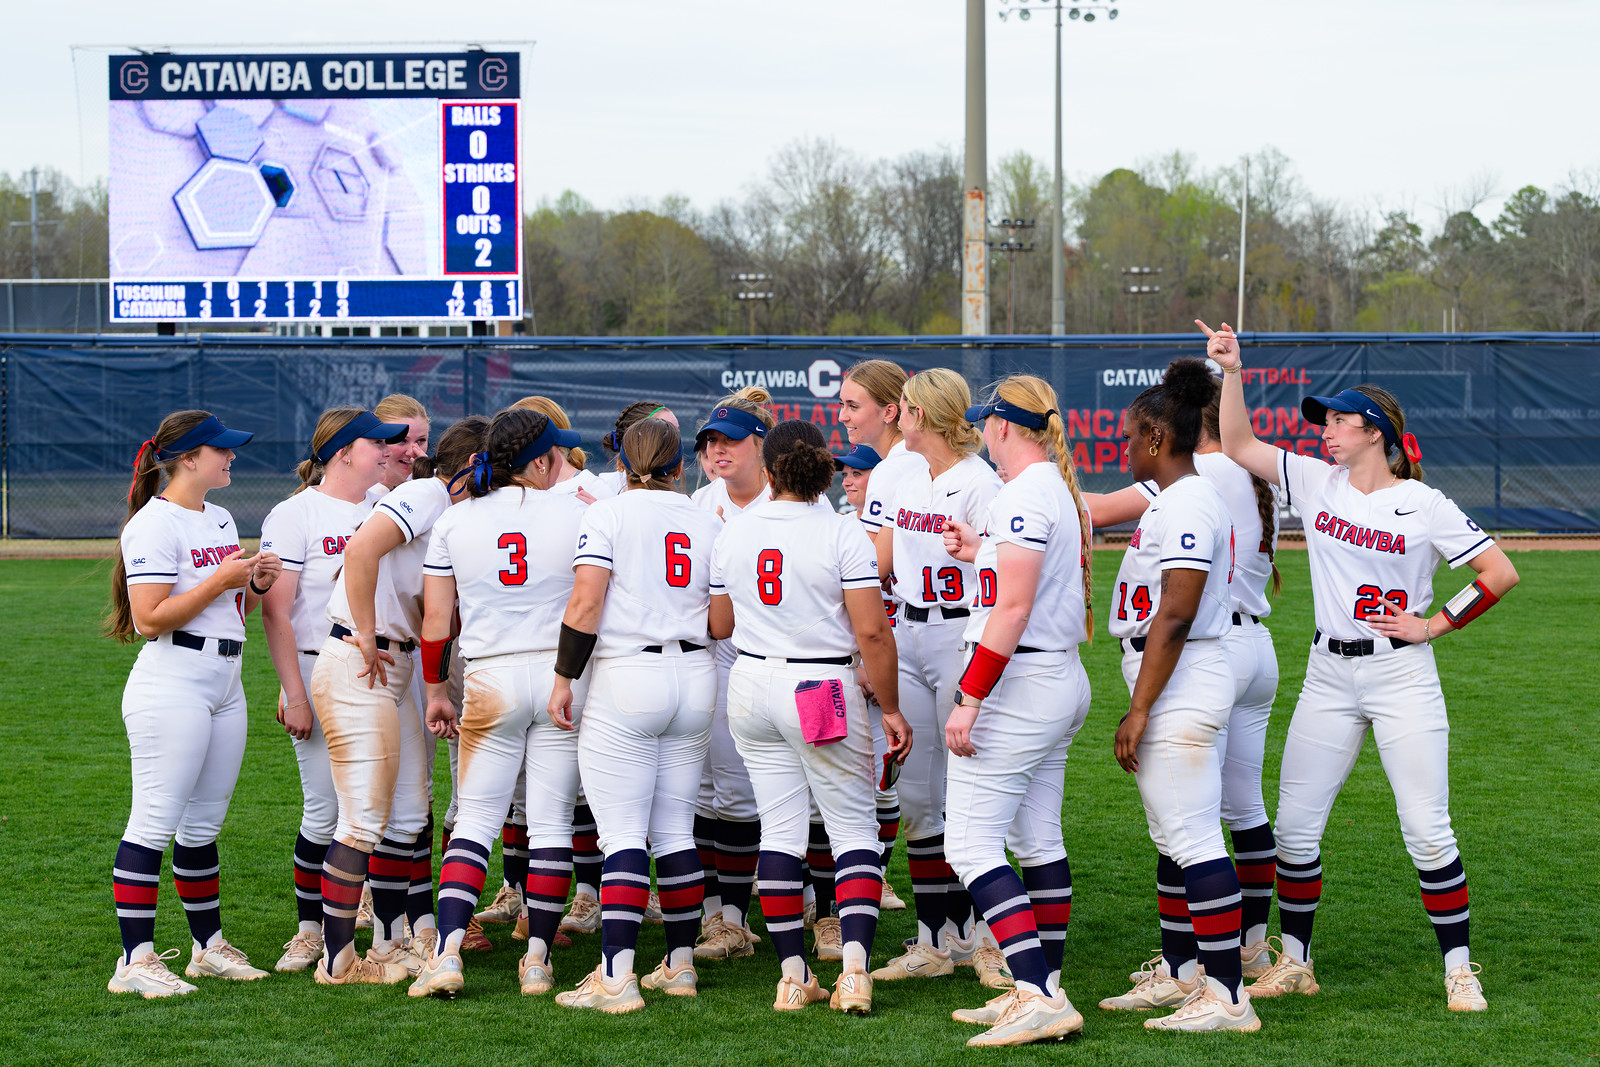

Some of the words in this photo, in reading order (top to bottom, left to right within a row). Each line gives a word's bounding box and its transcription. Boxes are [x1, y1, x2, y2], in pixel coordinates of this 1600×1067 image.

[161, 61, 312, 92] CATAWBA
[322, 59, 467, 91] COLLEGE
[451, 105, 501, 126] BALLS
[469, 130, 487, 160] 0
[444, 162, 515, 183] STRIKES
[472, 185, 490, 214] 0
[456, 214, 502, 235] OUTS
[474, 238, 492, 267] 2
[115, 284, 186, 300] TUSCULUM
[202, 281, 213, 300] 1
[226, 281, 240, 300] 0
[257, 281, 268, 300] 1
[285, 281, 295, 300] 1
[312, 281, 322, 299] 1
[336, 280, 349, 299] 0
[451, 280, 464, 299] 4
[480, 280, 492, 299] 8
[505, 280, 515, 299] 1
[119, 301, 187, 317] CATAWBA
[199, 299, 212, 318] 3
[230, 299, 240, 318] 1
[254, 299, 266, 318] 2
[285, 299, 295, 317] 1
[309, 299, 321, 317] 2
[336, 299, 349, 317] 3
[446, 299, 465, 317] 12
[473, 299, 493, 317] 15
[506, 299, 516, 317] 1
[721, 370, 808, 388] CATAWBA
[808, 359, 841, 398] C
[1103, 369, 1167, 386] CATAW
[869, 500, 882, 516] C
[896, 508, 952, 534] CATAWB
[1010, 516, 1025, 532] C
[1314, 511, 1406, 555] CATAWBA
[578, 533, 588, 549] C
[1180, 533, 1196, 550] C
[497, 531, 528, 586] 3
[664, 531, 691, 588] 6
[757, 548, 783, 606] 8
[922, 566, 964, 602] 13
[972, 567, 998, 607] 0
[1118, 581, 1153, 621] 14
[828, 679, 845, 718] CATAW
